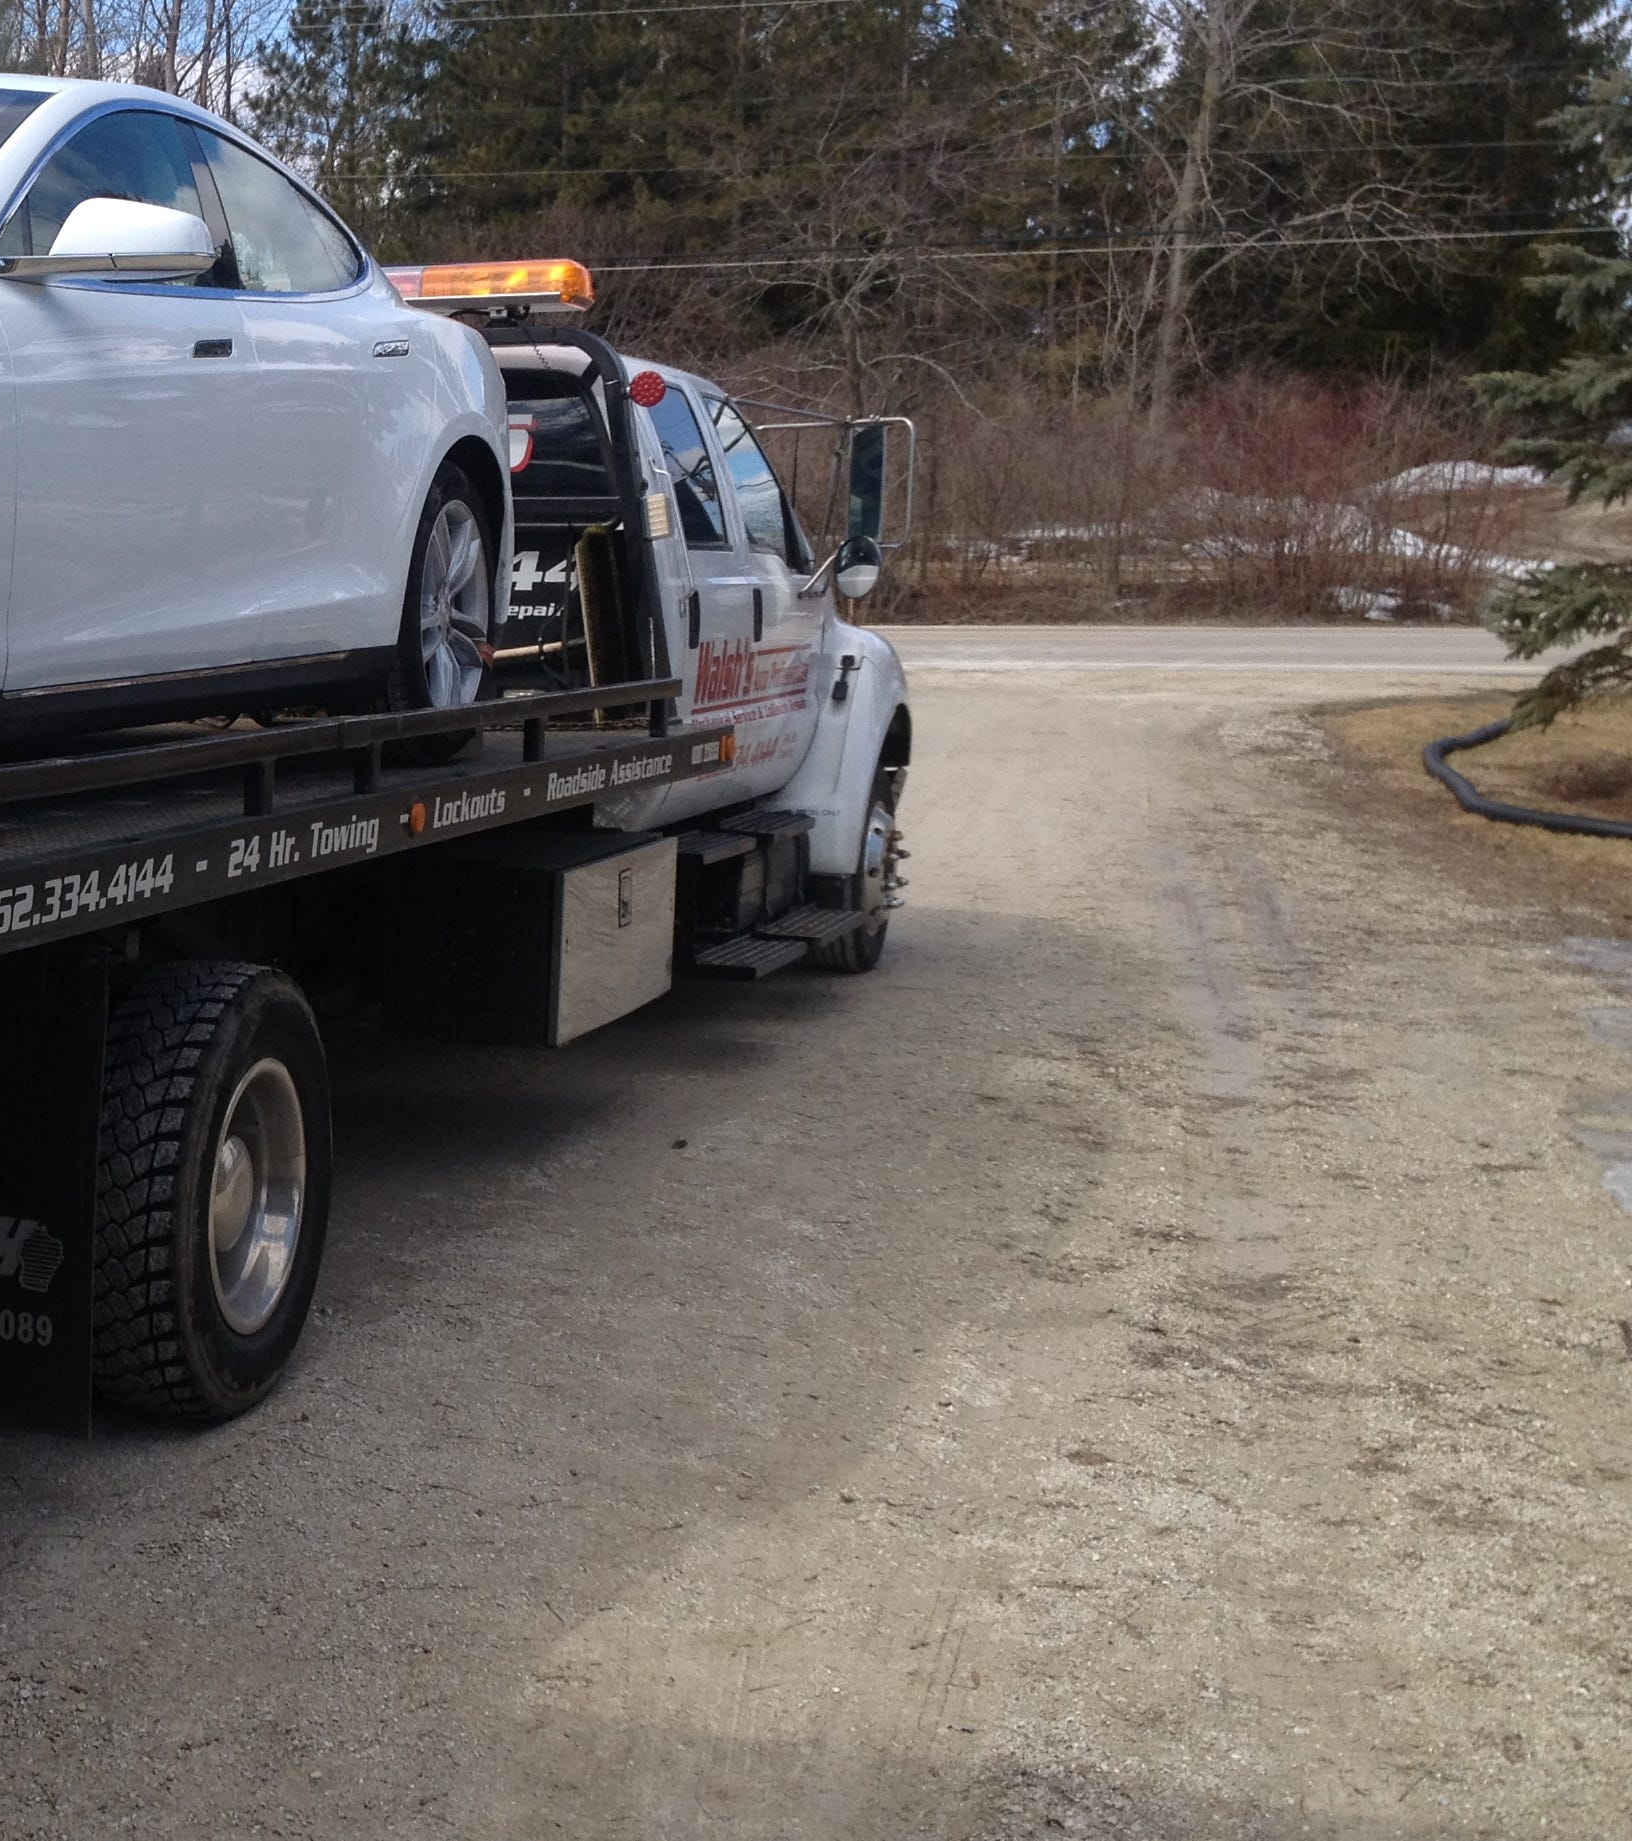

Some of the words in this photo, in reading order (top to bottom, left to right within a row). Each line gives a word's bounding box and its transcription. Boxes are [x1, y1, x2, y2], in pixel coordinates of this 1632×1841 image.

[227, 835, 260, 878] 24
[269, 830, 300, 868] Hr.
[310, 815, 380, 854] Towing
[432, 788, 506, 829] Lockouts
[546, 763, 605, 802] Roadside
[608, 753, 672, 787] Assistance
